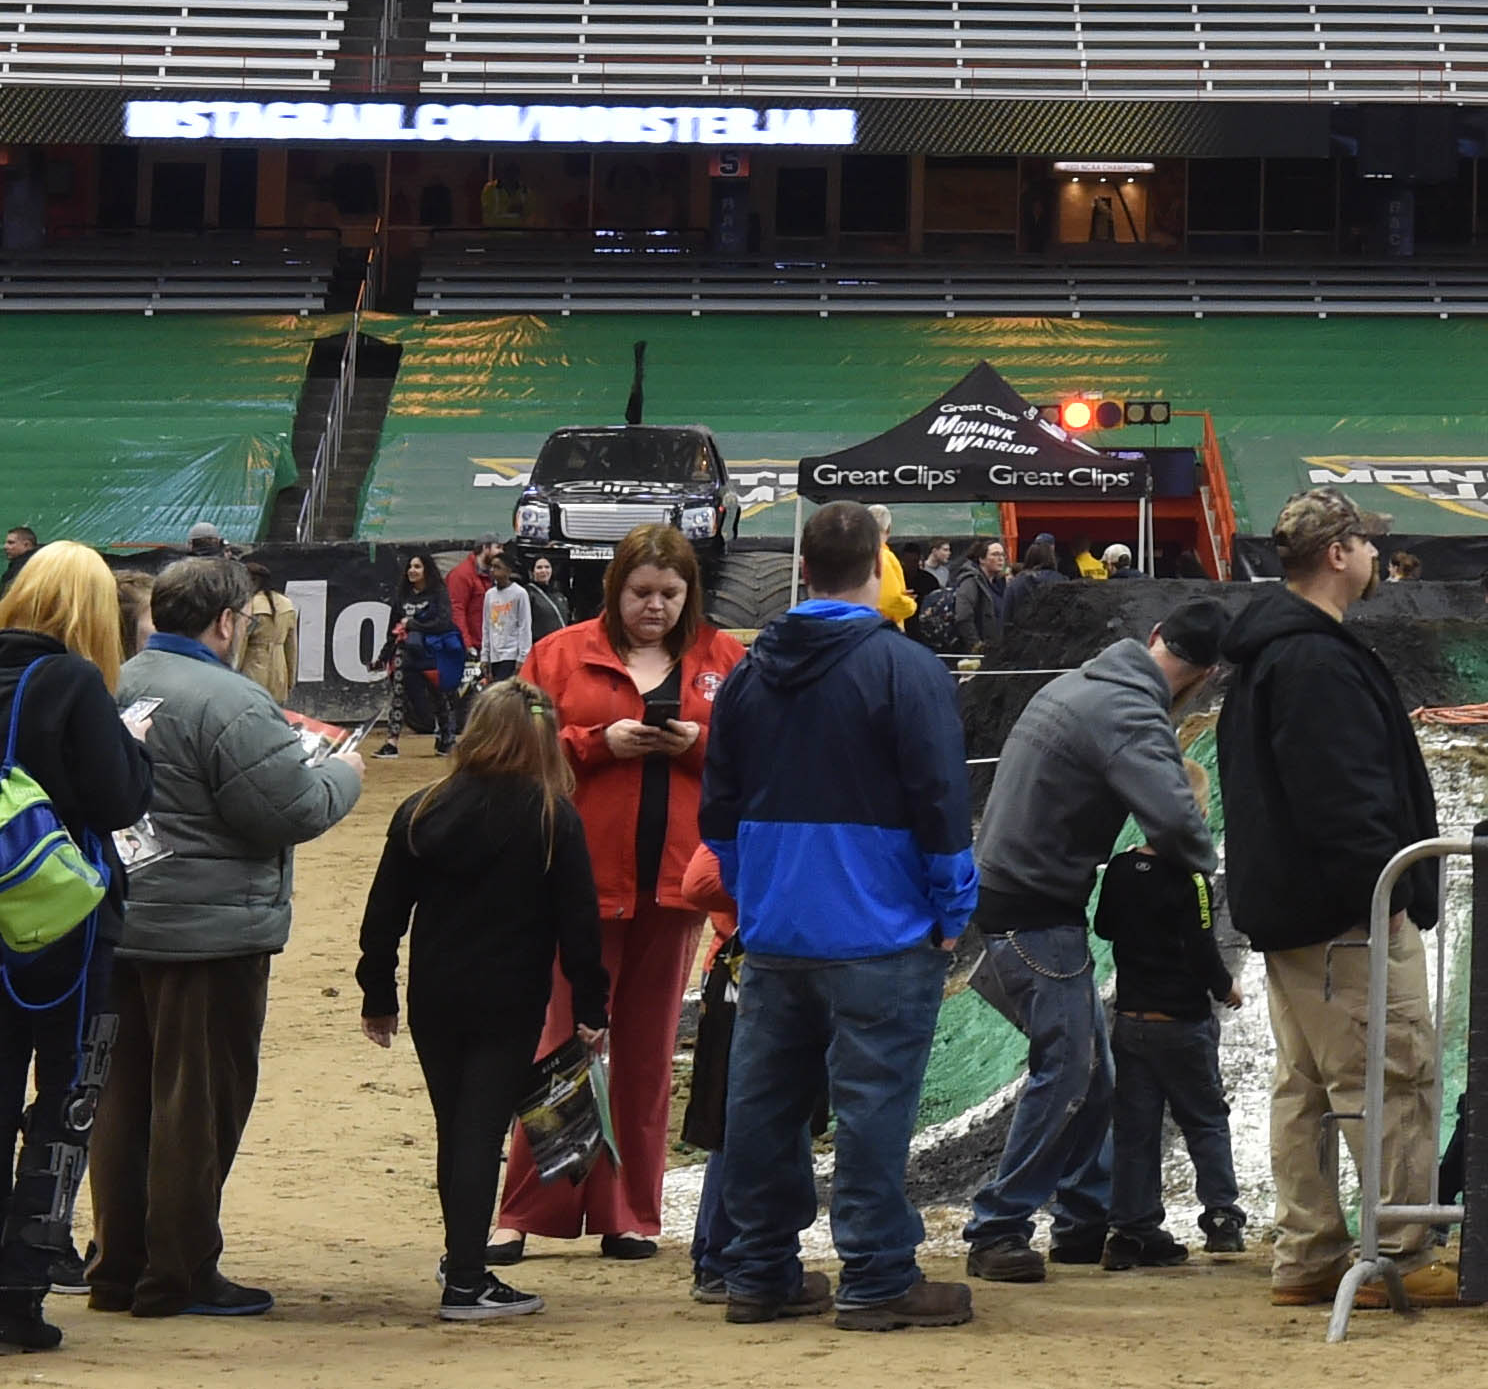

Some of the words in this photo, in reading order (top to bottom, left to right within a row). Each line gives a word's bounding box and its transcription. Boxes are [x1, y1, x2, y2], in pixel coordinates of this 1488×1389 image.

[940, 402, 983, 414] Great
[813, 464, 890, 486] Great
[893, 464, 956, 491] Clips
[988, 466, 1065, 487] Great
[1067, 467, 1130, 493] Clips
